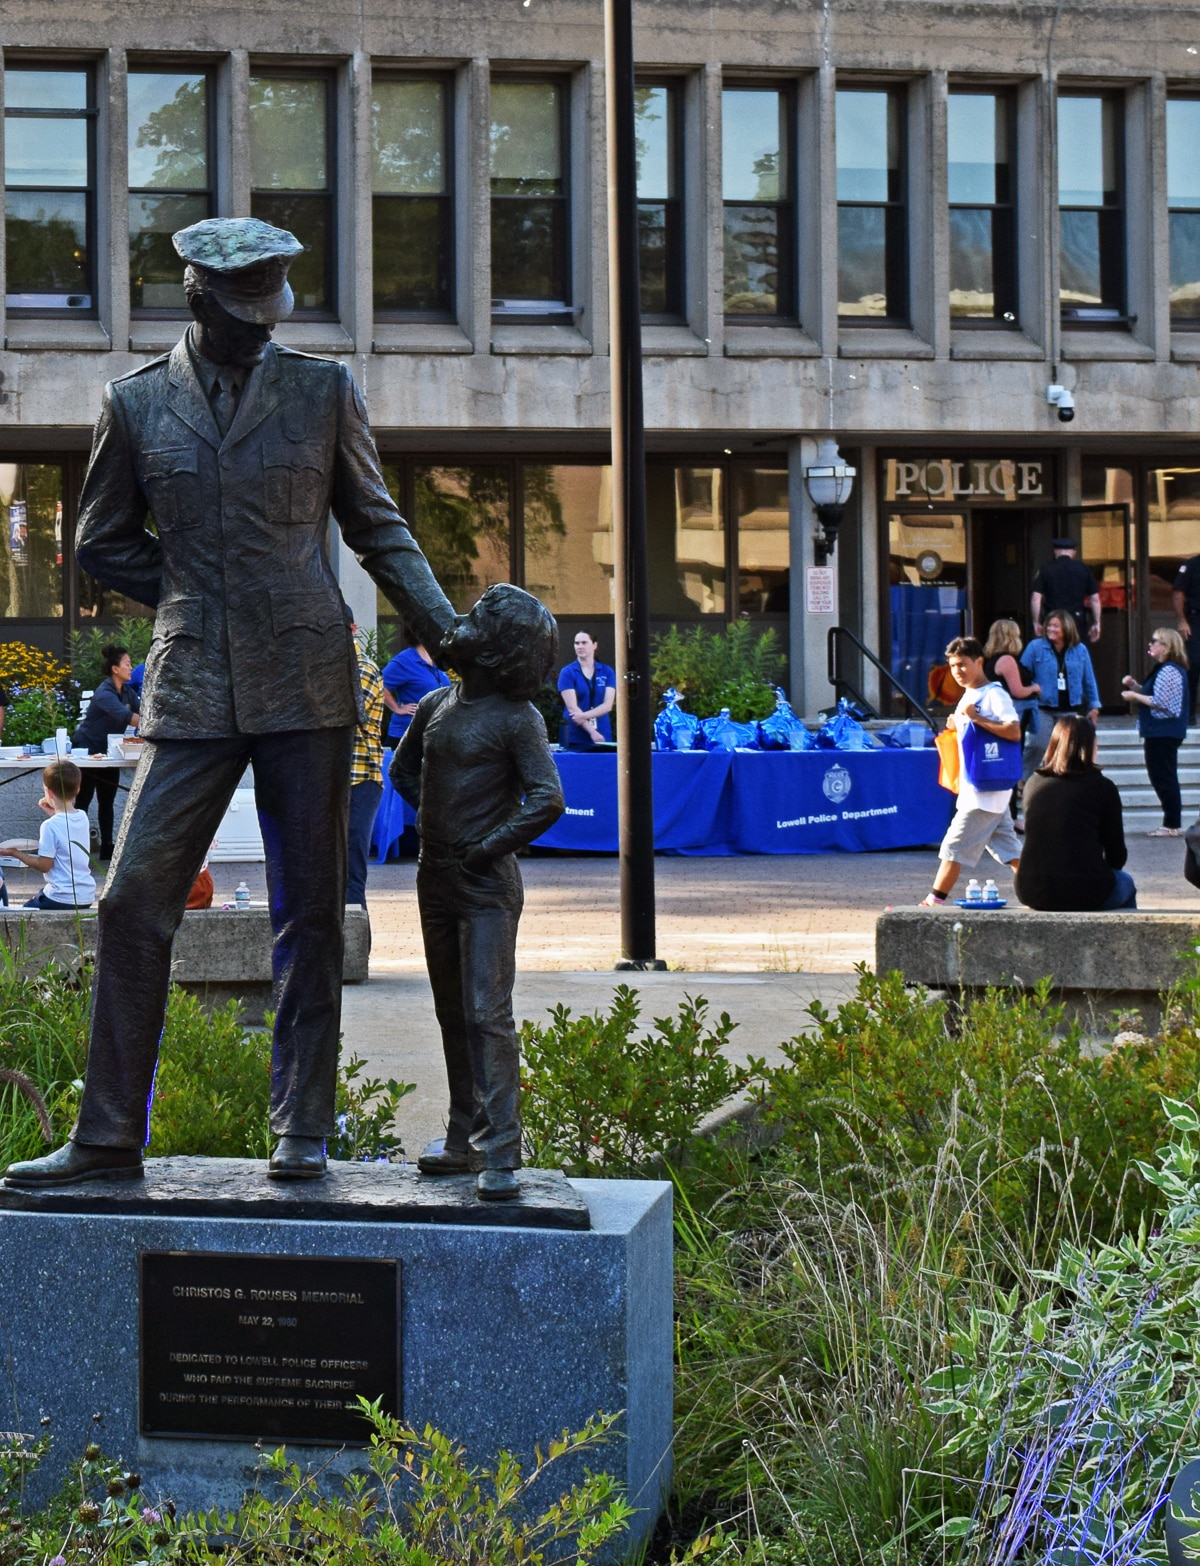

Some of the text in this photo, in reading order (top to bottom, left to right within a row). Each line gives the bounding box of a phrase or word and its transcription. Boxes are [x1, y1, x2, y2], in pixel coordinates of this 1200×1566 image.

[896, 462, 1042, 494] POLICE
[565, 806, 594, 816] tment
[776, 805, 898, 828] Lowell Police Department
[172, 1286, 365, 1304] CHRISTOS G. ROUSES MEMORIAL
[238, 1315, 259, 1326] MAY
[262, 1316, 275, 1328] 22,
[169, 1352, 368, 1370] DEDICATED TO LOWELL POLICE OFFICERS
[184, 1373, 356, 1390] WHO PAID THE SUPREME SACRIFICE
[159, 1392, 196, 1404] DURING
[199, 1394, 218, 1404] THE
[221, 1395, 294, 1408] PERFORMANCE
[297, 1398, 312, 1408] OF
[314, 1399, 343, 1410] THEIR
